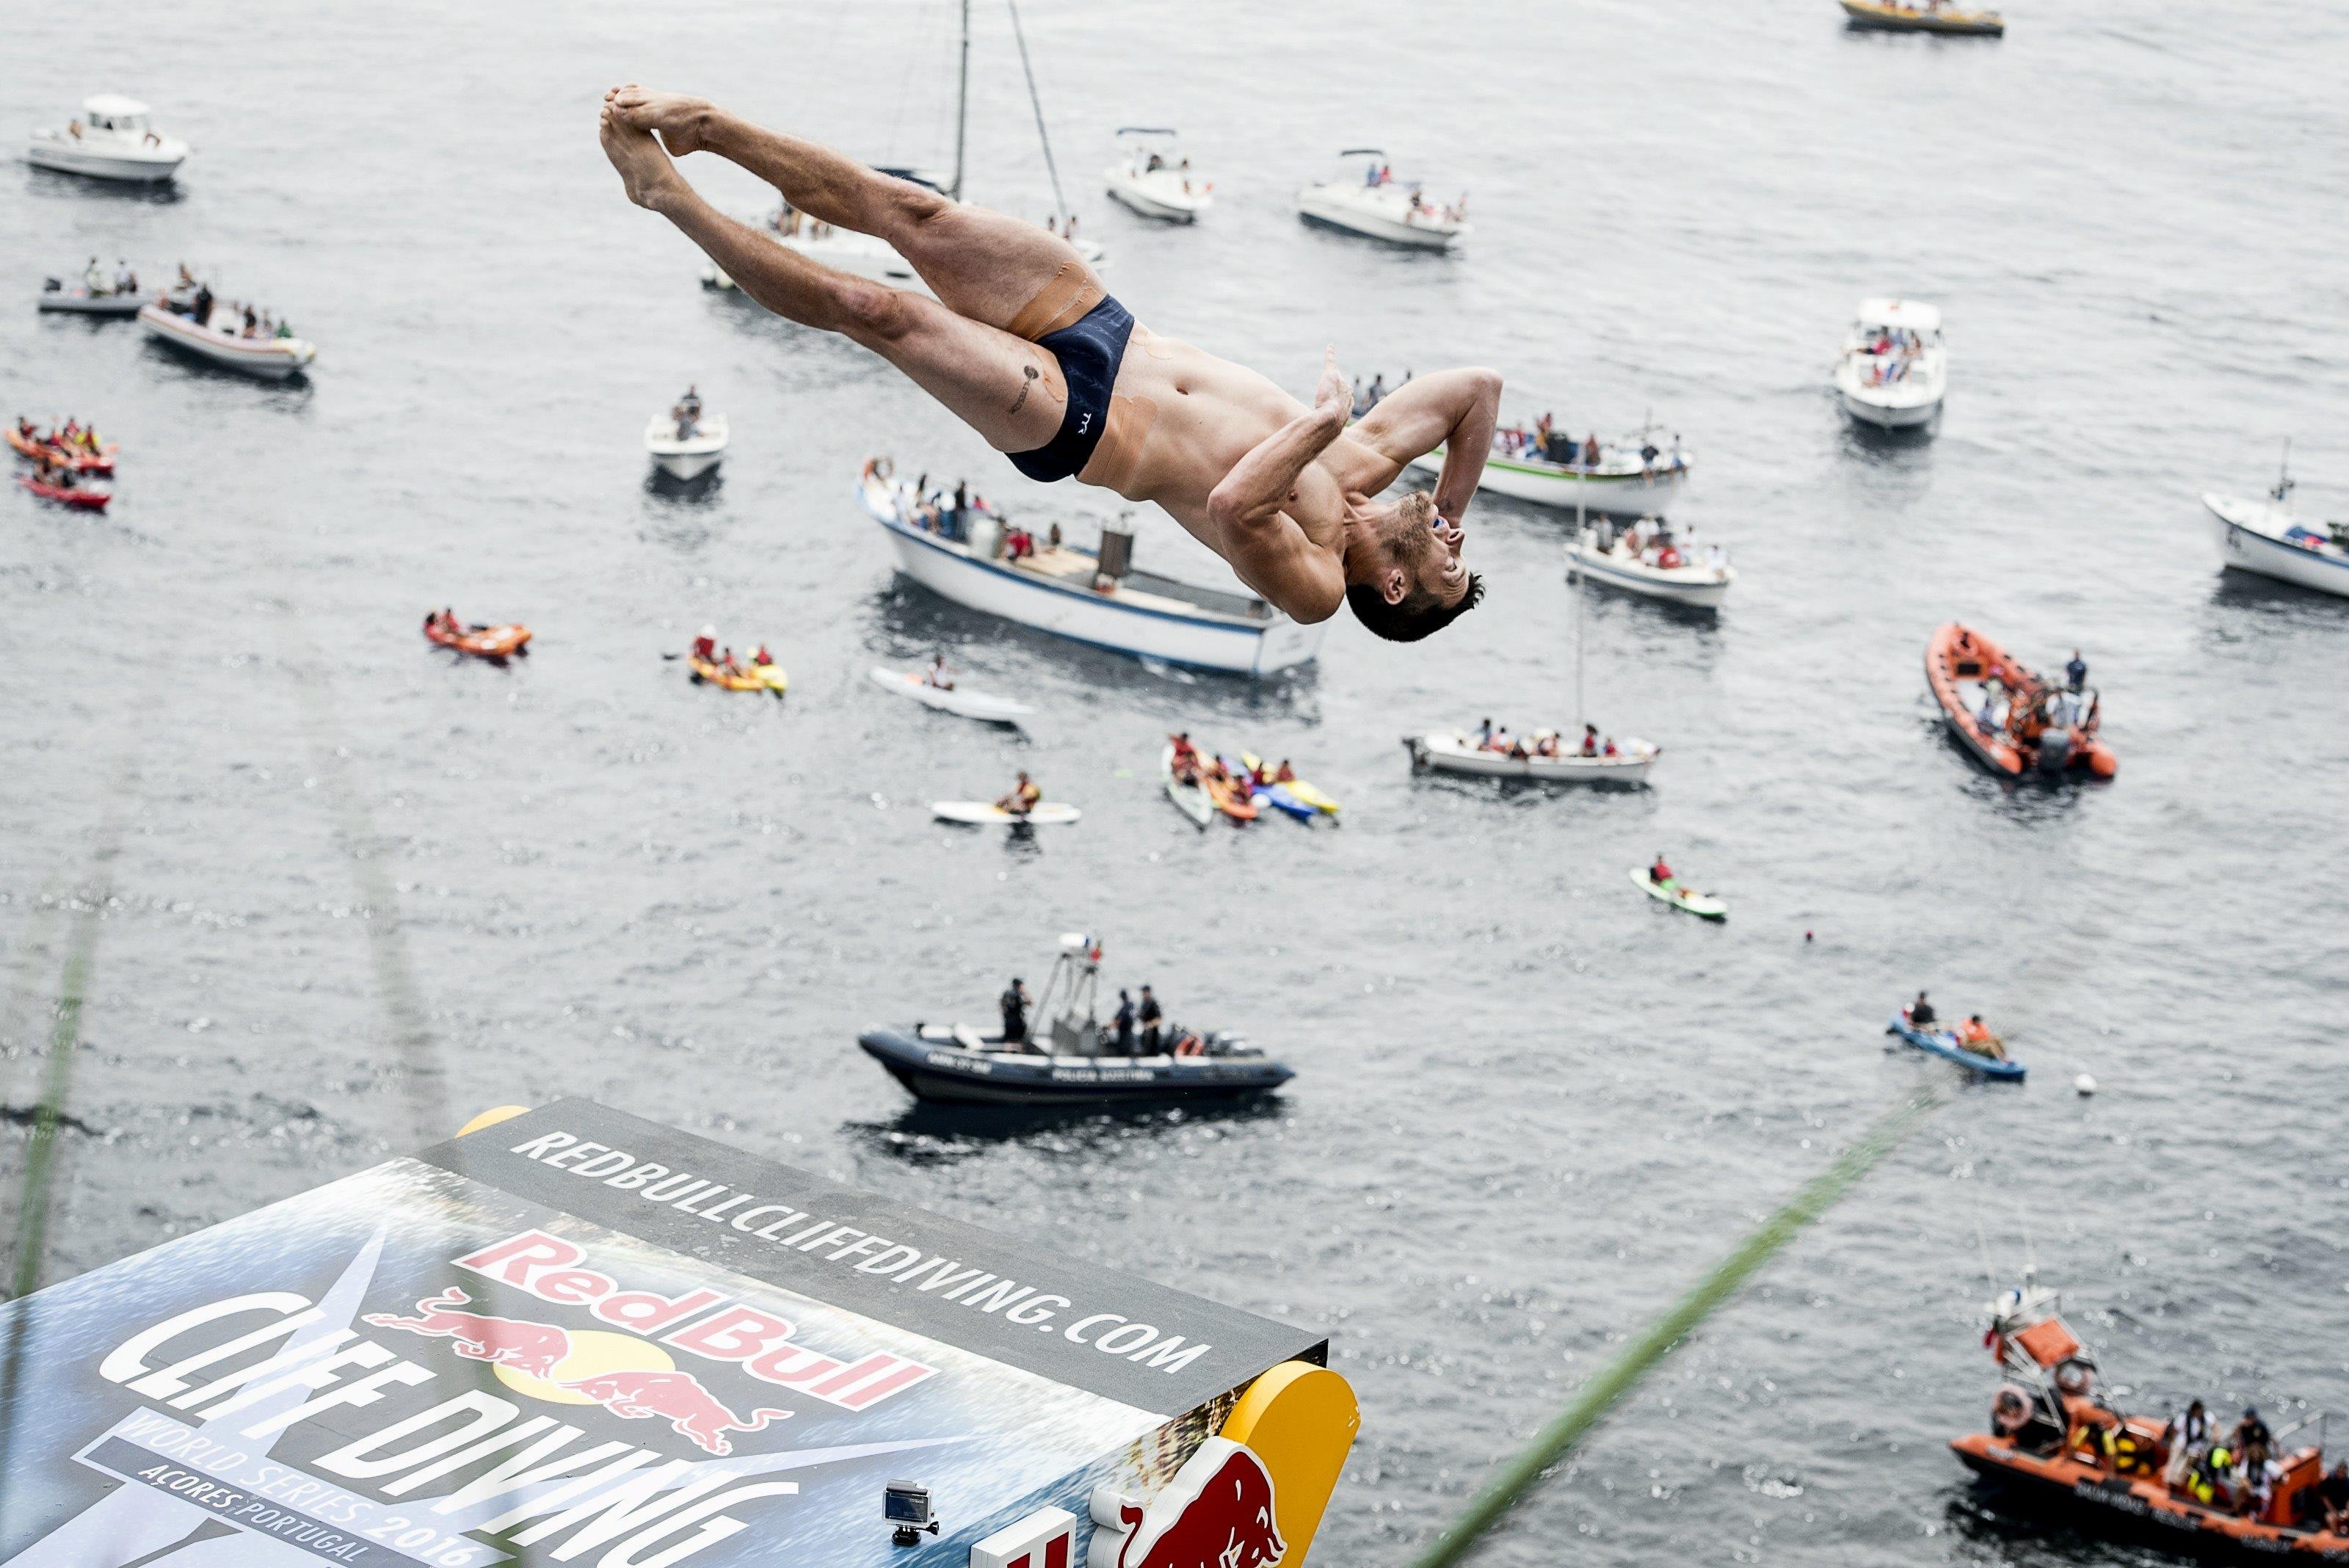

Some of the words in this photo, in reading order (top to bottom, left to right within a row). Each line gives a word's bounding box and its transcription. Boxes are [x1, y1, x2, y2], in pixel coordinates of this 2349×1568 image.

[510, 1131, 1212, 1374] REDBULLCLIFFDIVING.COM
[99, 1291, 437, 1440] CLIFF
[311, 1389, 799, 1568] DIVING
[118, 1415, 248, 1470] WORLD
[239, 1467, 373, 1522] SERIES
[362, 1517, 483, 1566] 2016
[233, 1503, 368, 1562] PORTUGAL
